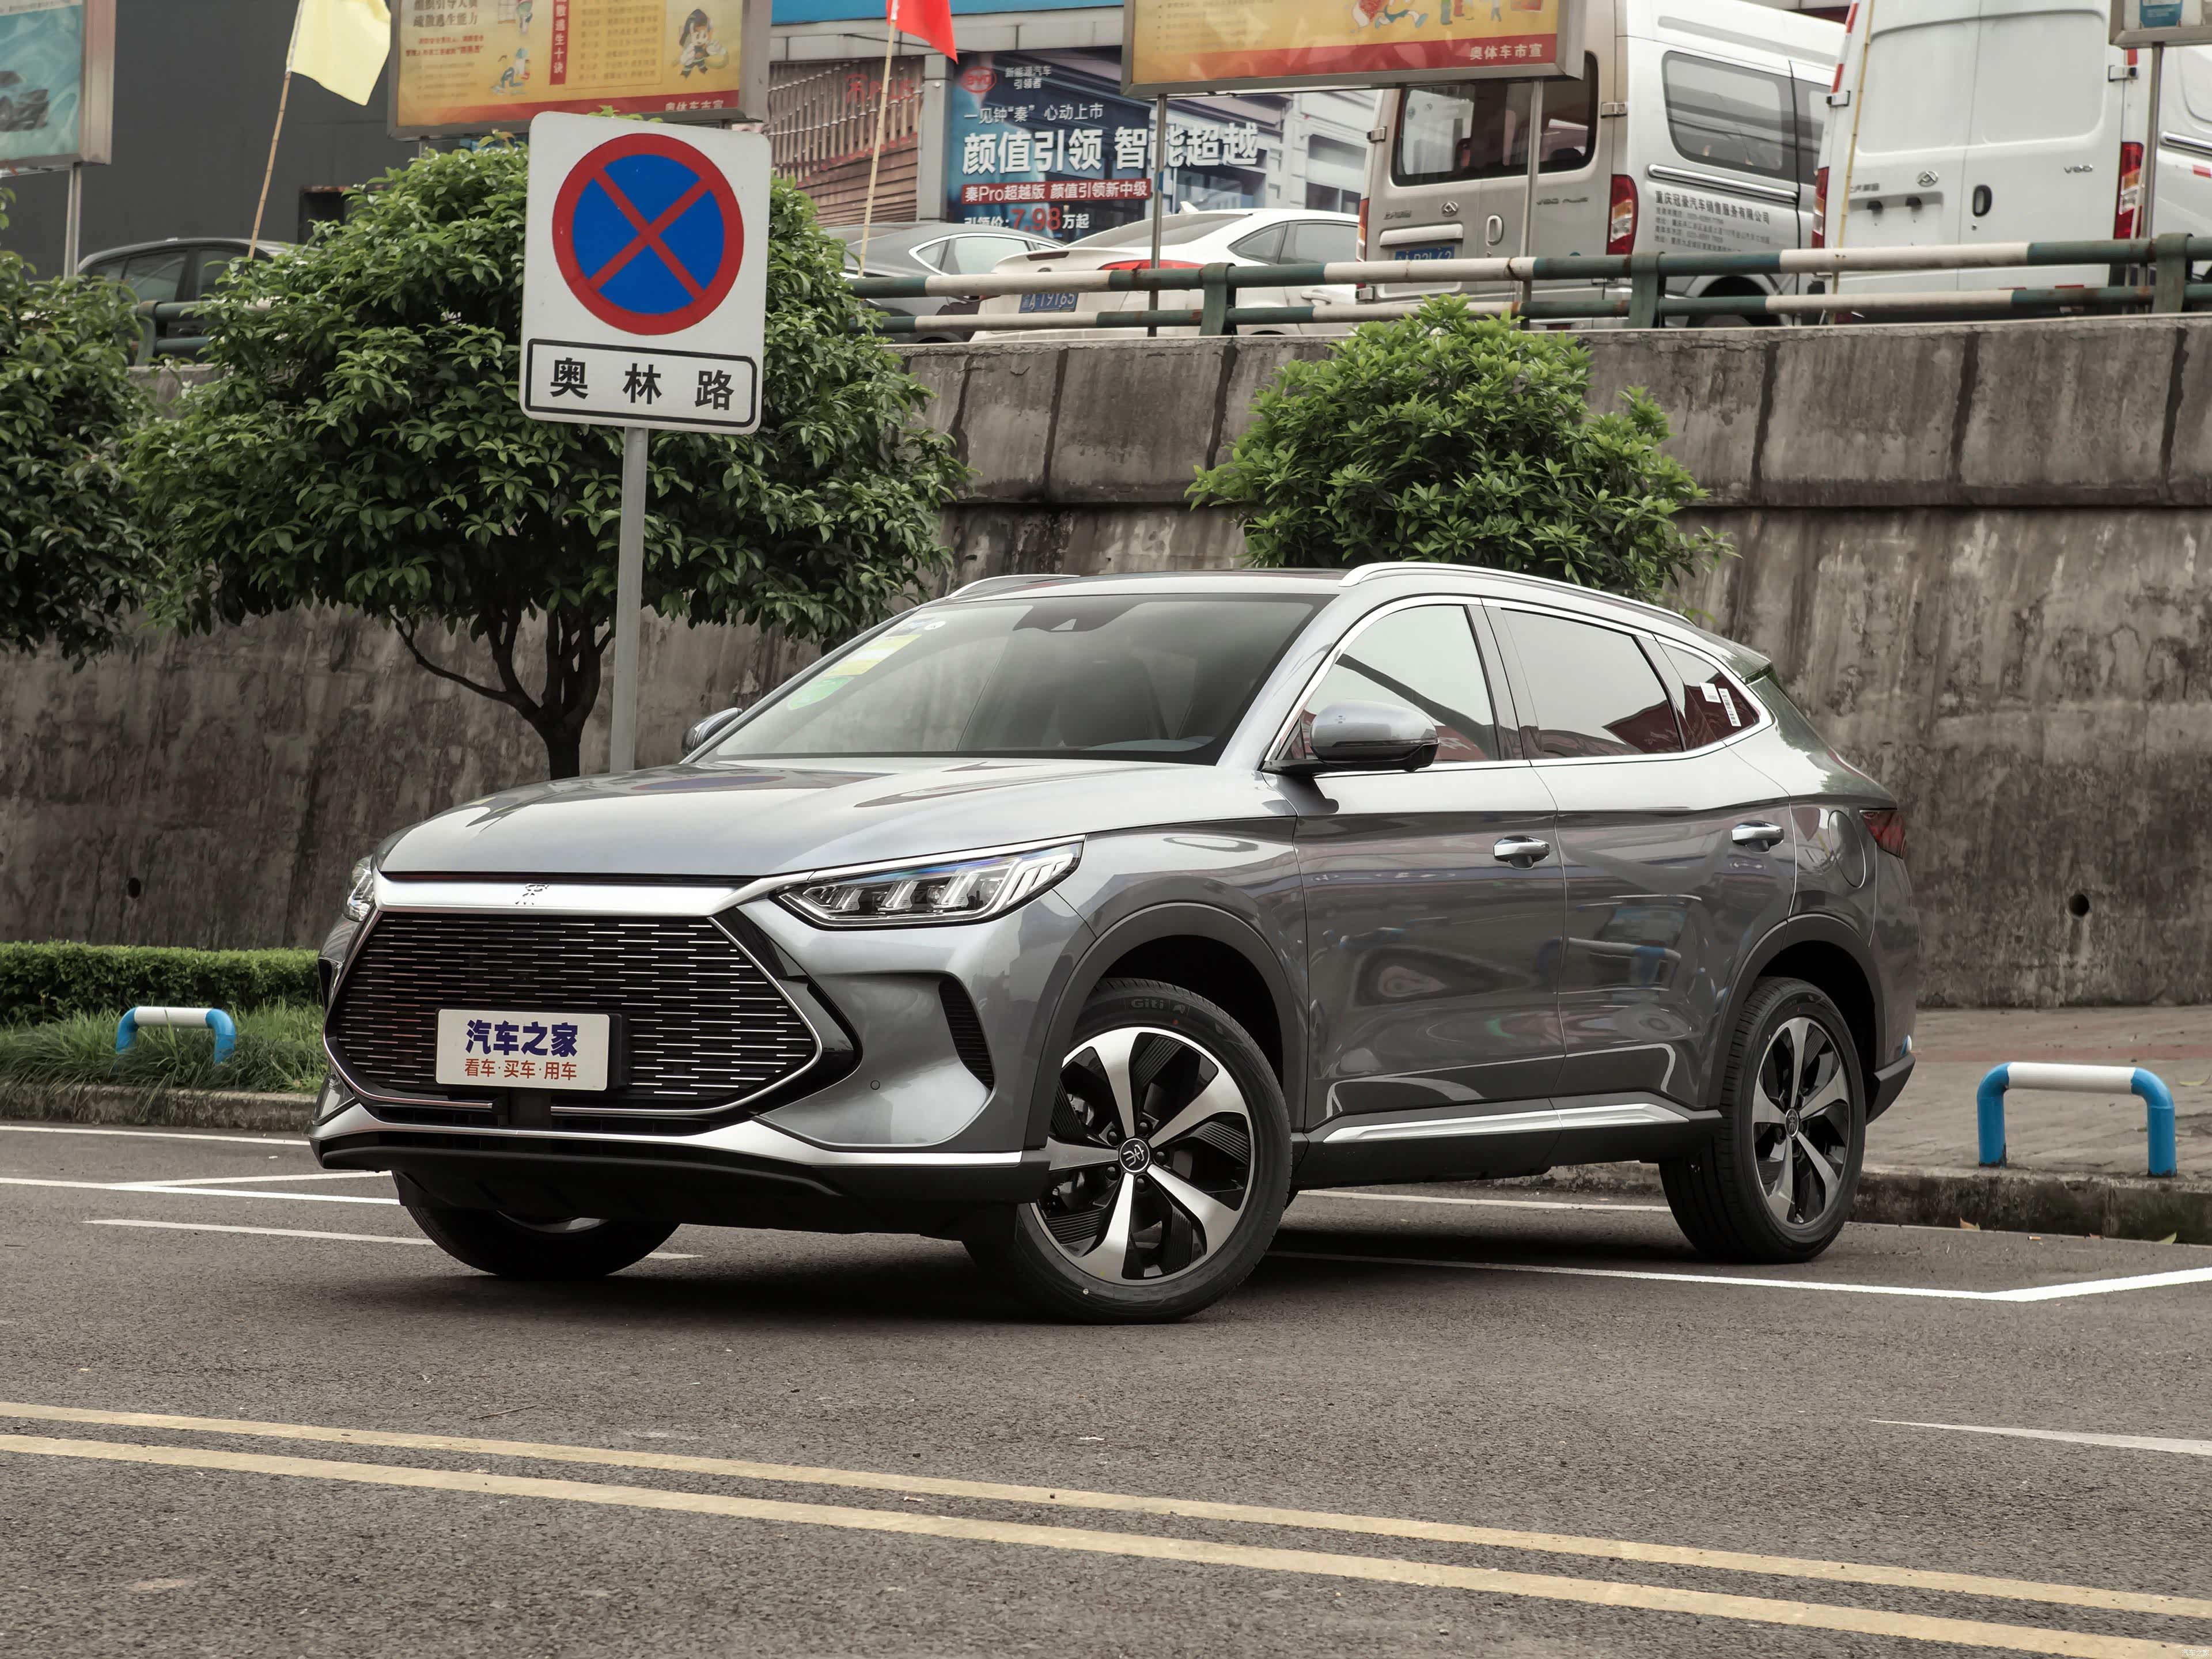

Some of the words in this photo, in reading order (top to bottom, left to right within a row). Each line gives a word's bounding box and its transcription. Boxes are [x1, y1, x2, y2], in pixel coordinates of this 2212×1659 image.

[554, 0, 567, 74] 散逃生十诀
[1469, 43, 1543, 60] 奥体车市宣
[1014, 78, 1041, 89] 引领者
[1044, 103, 1104, 121] 心动上市
[962, 128, 1104, 175] 颜值引领
[1114, 123, 1259, 170] 智能超越
[965, 184, 1046, 202] 秦Pro超越版
[1050, 180, 1148, 199] 颜值引领新中级
[550, 357, 734, 411] 奥林路
[1131, 998, 1164, 1009] Giti
[465, 1020, 578, 1058] 汽车之家
[464, 1058, 577, 1081] 看车·买车·用车
